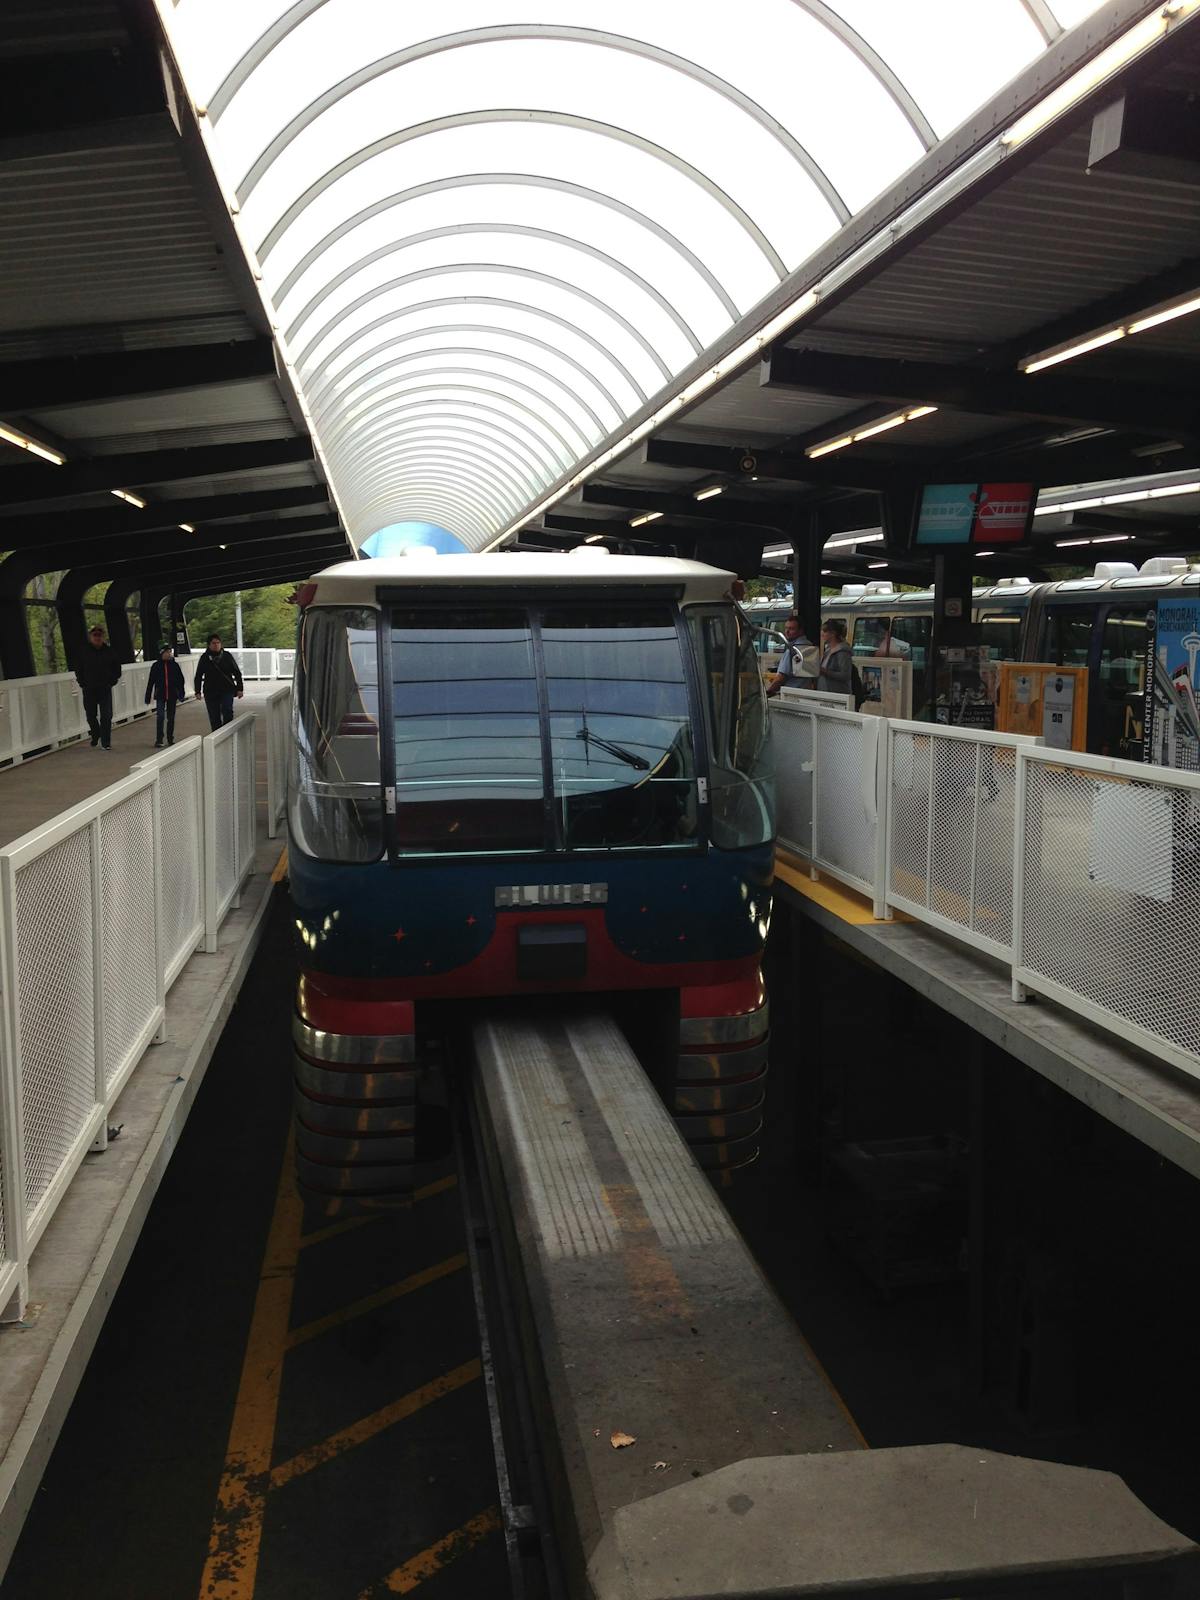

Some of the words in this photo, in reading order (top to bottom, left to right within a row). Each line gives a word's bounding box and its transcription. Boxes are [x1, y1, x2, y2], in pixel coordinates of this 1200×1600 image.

[1159, 608, 1198, 622] MONORAIL
[1146, 637, 1154, 693] MONORAIL
[1144, 695, 1152, 734] CENTER
